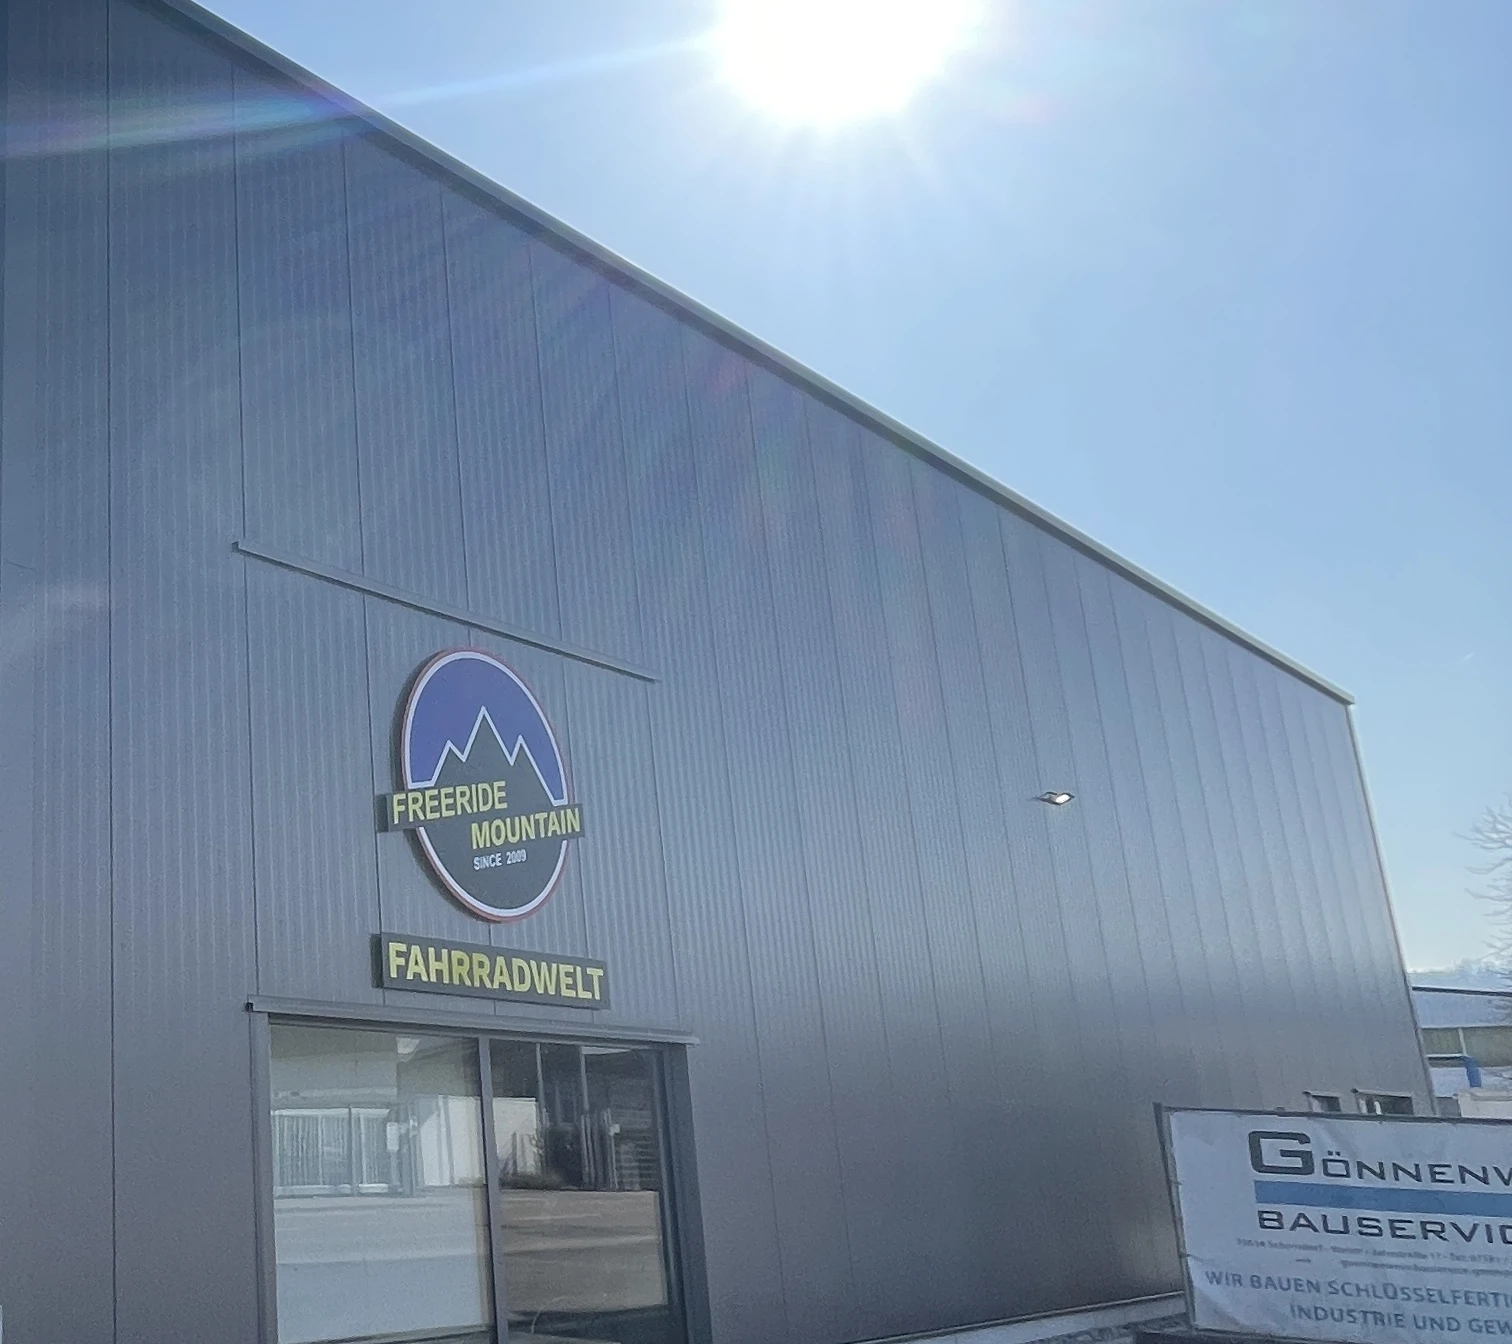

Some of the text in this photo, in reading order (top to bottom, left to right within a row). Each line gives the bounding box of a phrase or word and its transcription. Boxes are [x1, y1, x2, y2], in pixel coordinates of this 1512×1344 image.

[392, 780, 508, 825] FREERIDE
[471, 808, 581, 849] MOUNTAIN
[473, 852, 503, 871] SINCE
[388, 941, 604, 1001] FAHRRADWELT
[1204, 1270, 1512, 1309] WIR BAUEN SCHLÜSSELFERTI
[1289, 1304, 1406, 1329] INDUSTRIE
[1412, 1313, 1461, 1333] UND
